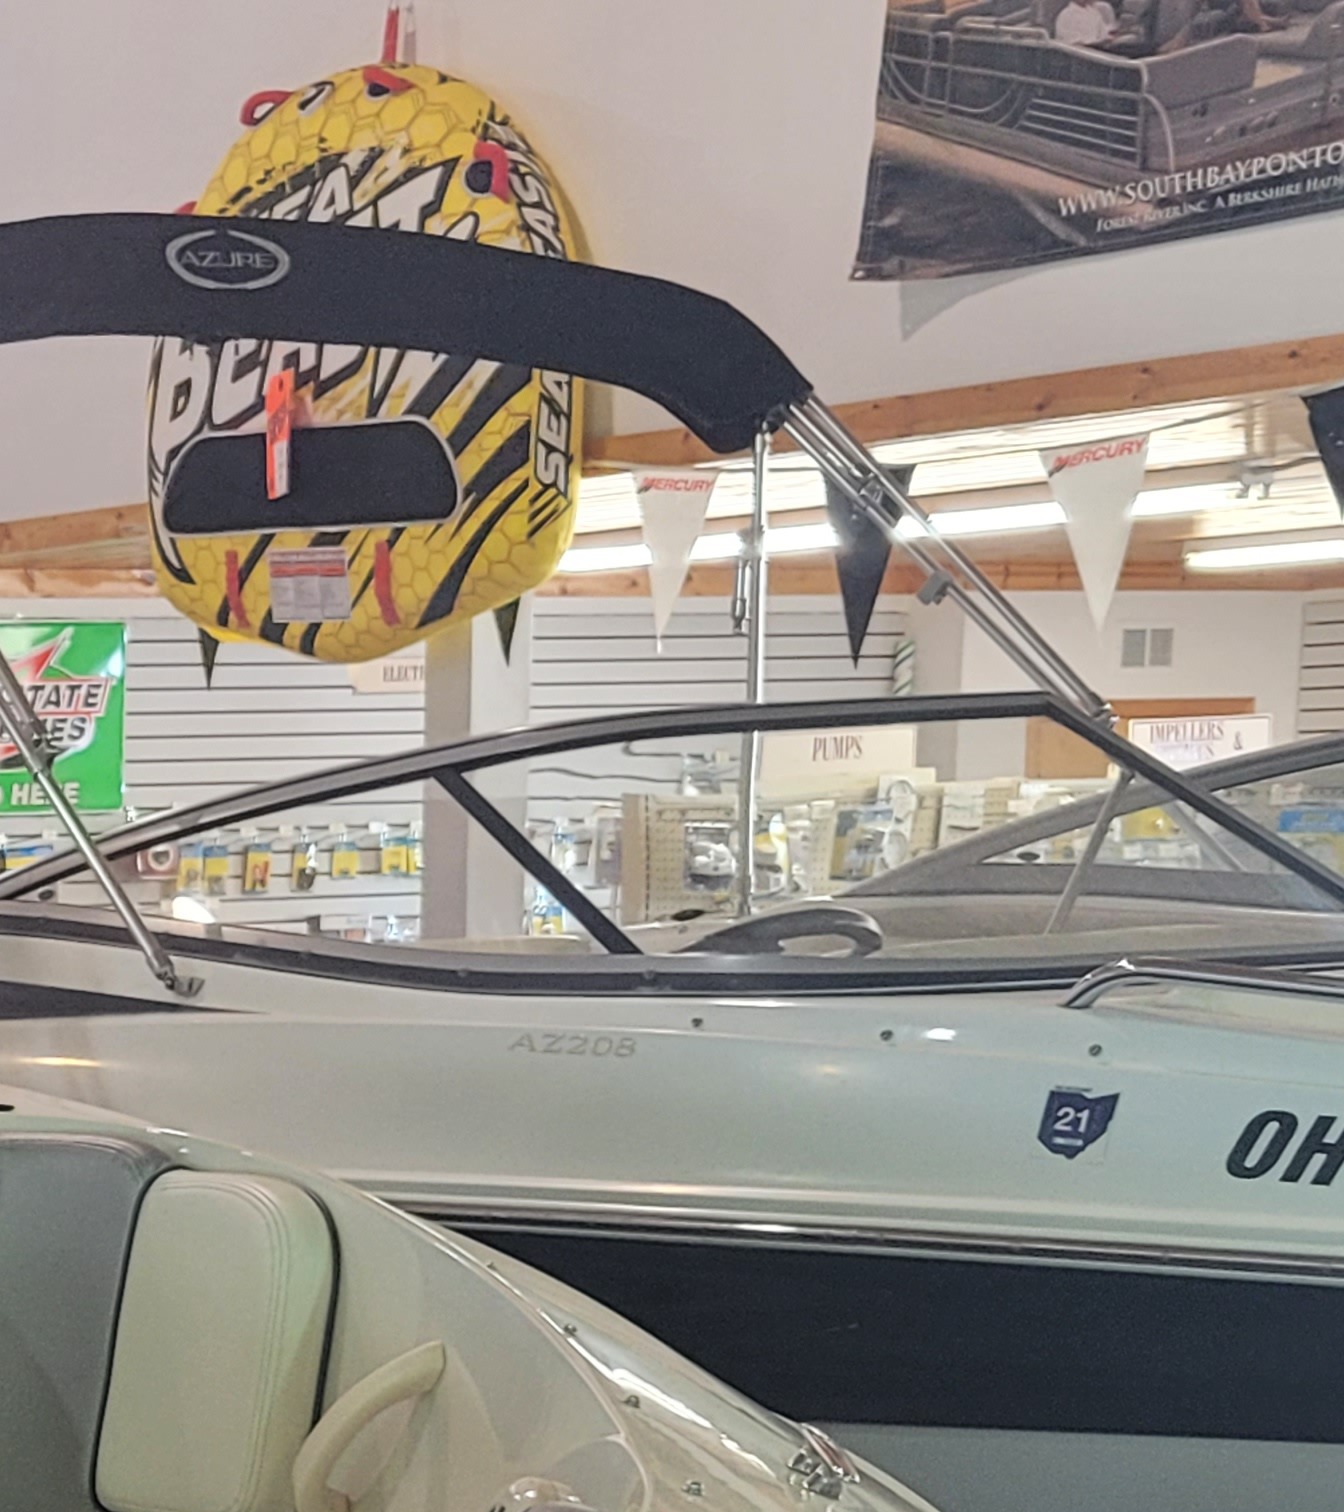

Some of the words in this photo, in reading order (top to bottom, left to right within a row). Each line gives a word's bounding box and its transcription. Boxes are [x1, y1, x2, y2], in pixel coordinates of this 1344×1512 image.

[180, 250, 276, 269] AZURE
[1054, 437, 1147, 468] MERCURY
[640, 476, 714, 492] MERCURY
[1150, 721, 1225, 744] IMPELLERS
[812, 735, 863, 761] PUMPS
[11, 782, 81, 807] HEE
[507, 1033, 637, 1057] AZ208
[1053, 1106, 1090, 1133] 21
[1226, 1109, 1344, 1186] OH
